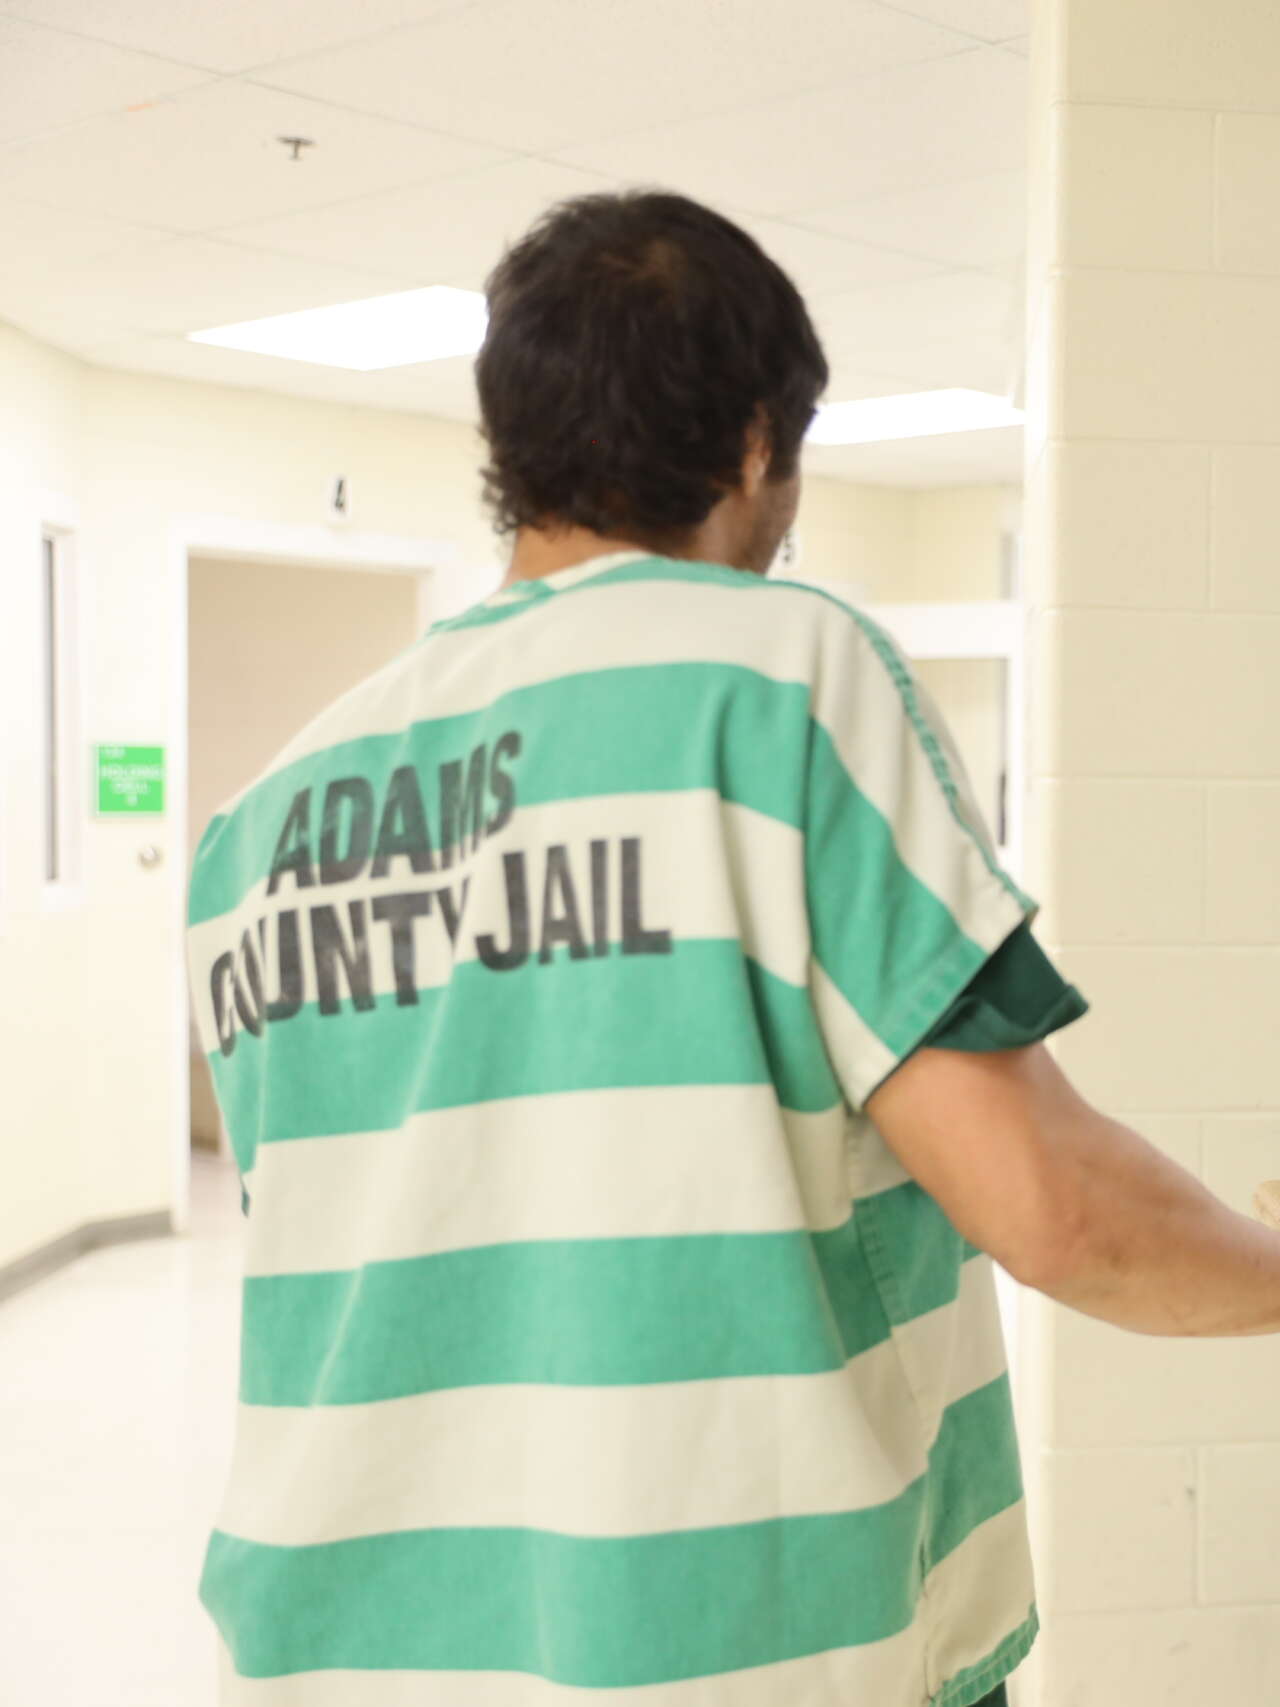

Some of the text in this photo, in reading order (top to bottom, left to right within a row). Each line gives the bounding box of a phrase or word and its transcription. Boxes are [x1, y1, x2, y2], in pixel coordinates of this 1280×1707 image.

[266, 731, 522, 897] ADAMS
[210, 837, 672, 1058] COUNTY JAIL
